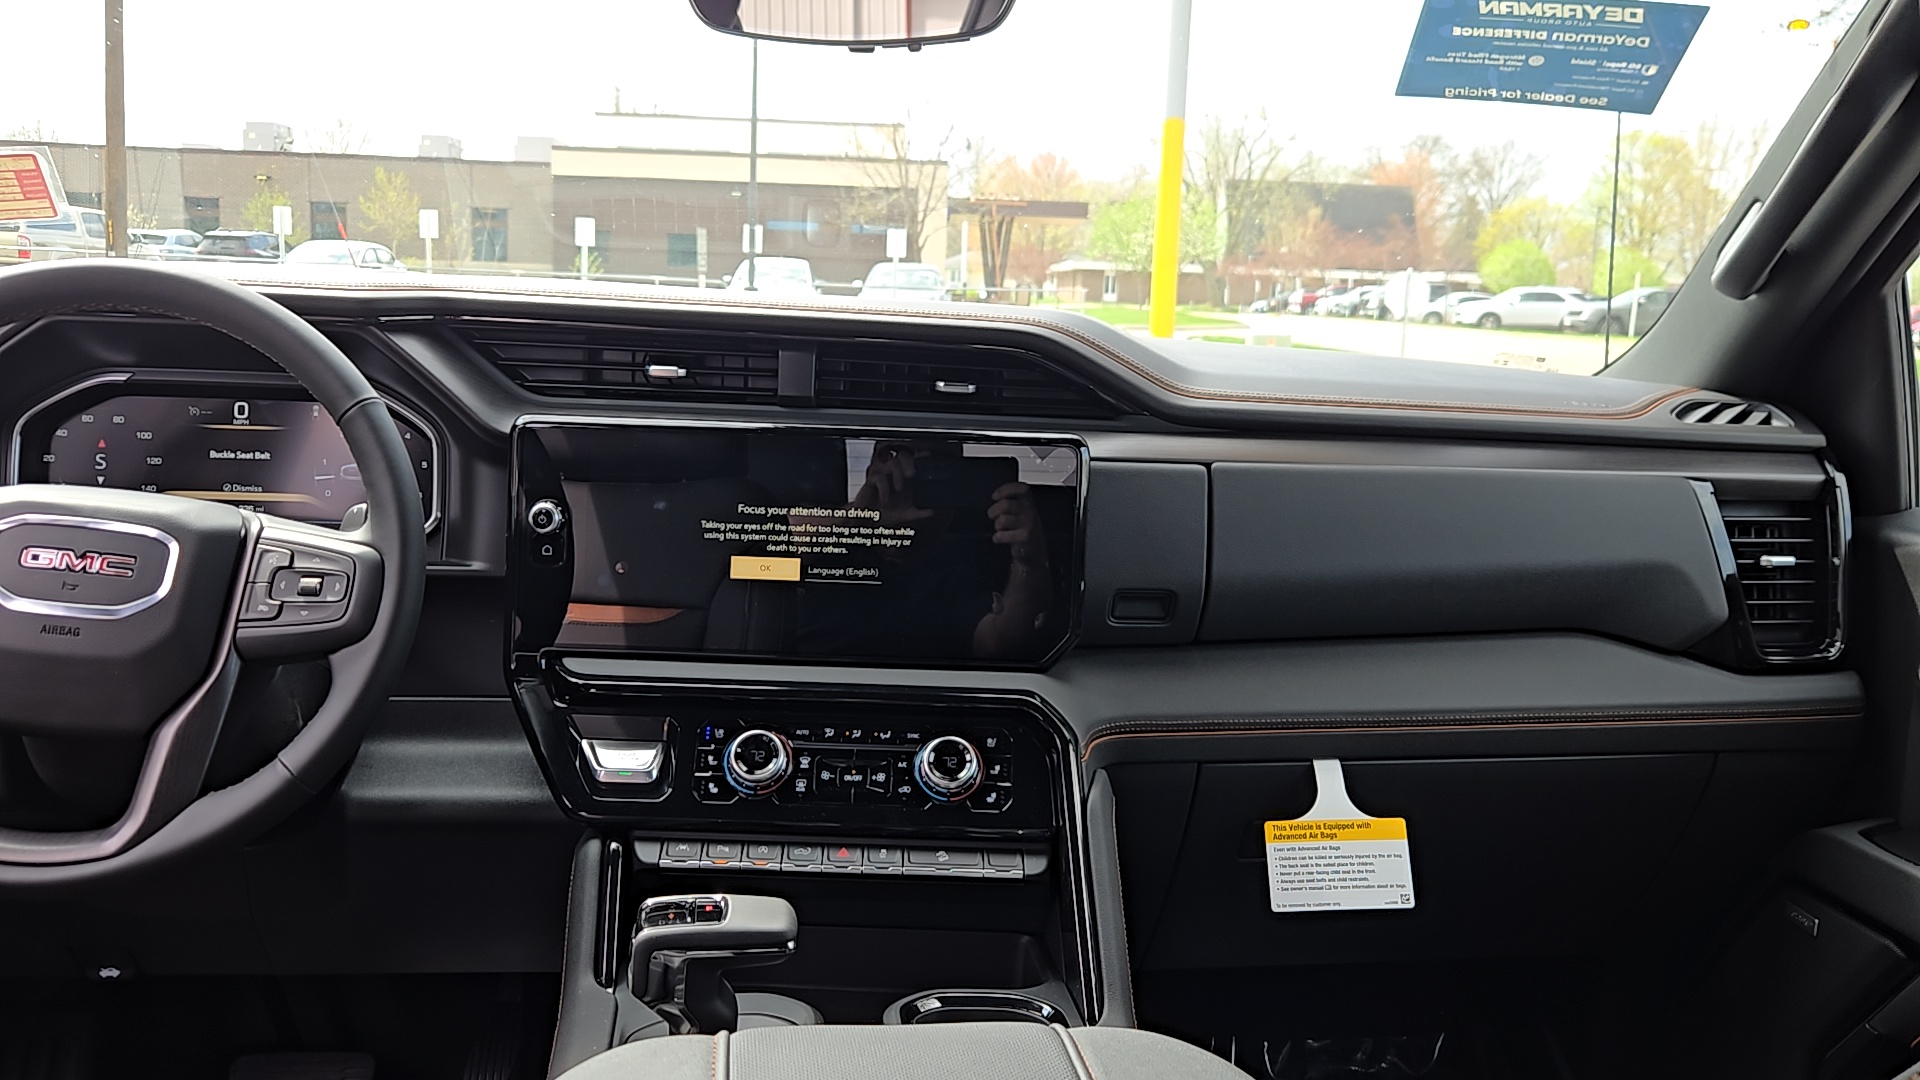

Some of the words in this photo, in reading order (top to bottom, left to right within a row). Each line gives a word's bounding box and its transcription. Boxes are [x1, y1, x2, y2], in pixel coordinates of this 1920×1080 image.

[233, 401, 249, 419] 0
[136, 431, 152, 440] 100
[404, 432, 411, 440] 4
[209, 450, 236, 460] Buckle
[236, 451, 254, 460] Seat
[254, 451, 271, 460] Belt
[95, 454, 107, 470] S
[146, 456, 162, 466] 120
[421, 461, 427, 469] 5
[141, 484, 157, 492] 140
[232, 484, 263, 492] Dismiss
[737, 503, 766, 515] Focus
[767, 507, 788, 517] your
[789, 507, 832, 517] attention
[833, 509, 847, 518] on
[847, 507, 881, 521] driving
[700, 519, 725, 532] Taking
[725, 523, 743, 531] your
[761, 523, 774, 531] off
[774, 523, 788, 531] the
[788, 523, 806, 532] road
[806, 523, 818, 532] for
[832, 525, 850, 535] long
[860, 527, 874, 535] too
[873, 526, 895, 535] often
[895, 527, 916, 536] while
[703, 531, 725, 541] using
[725, 531, 740, 540] this
[740, 533, 767, 542] system
[768, 533, 789, 542] could
[817, 535, 838, 543] crash
[839, 536, 872, 546] resulting
[872, 537, 880, 545] in
[880, 537, 902, 547] injury
[766, 543, 788, 552] death
[797, 547, 812, 555] you
[821, 545, 849, 554] others.
[20, 547, 136, 577] GMC
[759, 564, 772, 573] OK
[807, 566, 845, 577] Language
[845, 567, 880, 578] (English)
[39, 624, 81, 637] AIRBAG
[750, 750, 766, 762] 72
[942, 756, 958, 769] 72
[1272, 824, 1288, 832] This
[1288, 823, 1315, 831] Vehicle
[1323, 822, 1356, 831] Equipped
[1355, 821, 1372, 830] with
[1272, 832, 1308, 841] Advanced
[1308, 832, 1320, 840] Air
[1320, 831, 1339, 841] Bags
[1328, 844, 1342, 852] Bags
